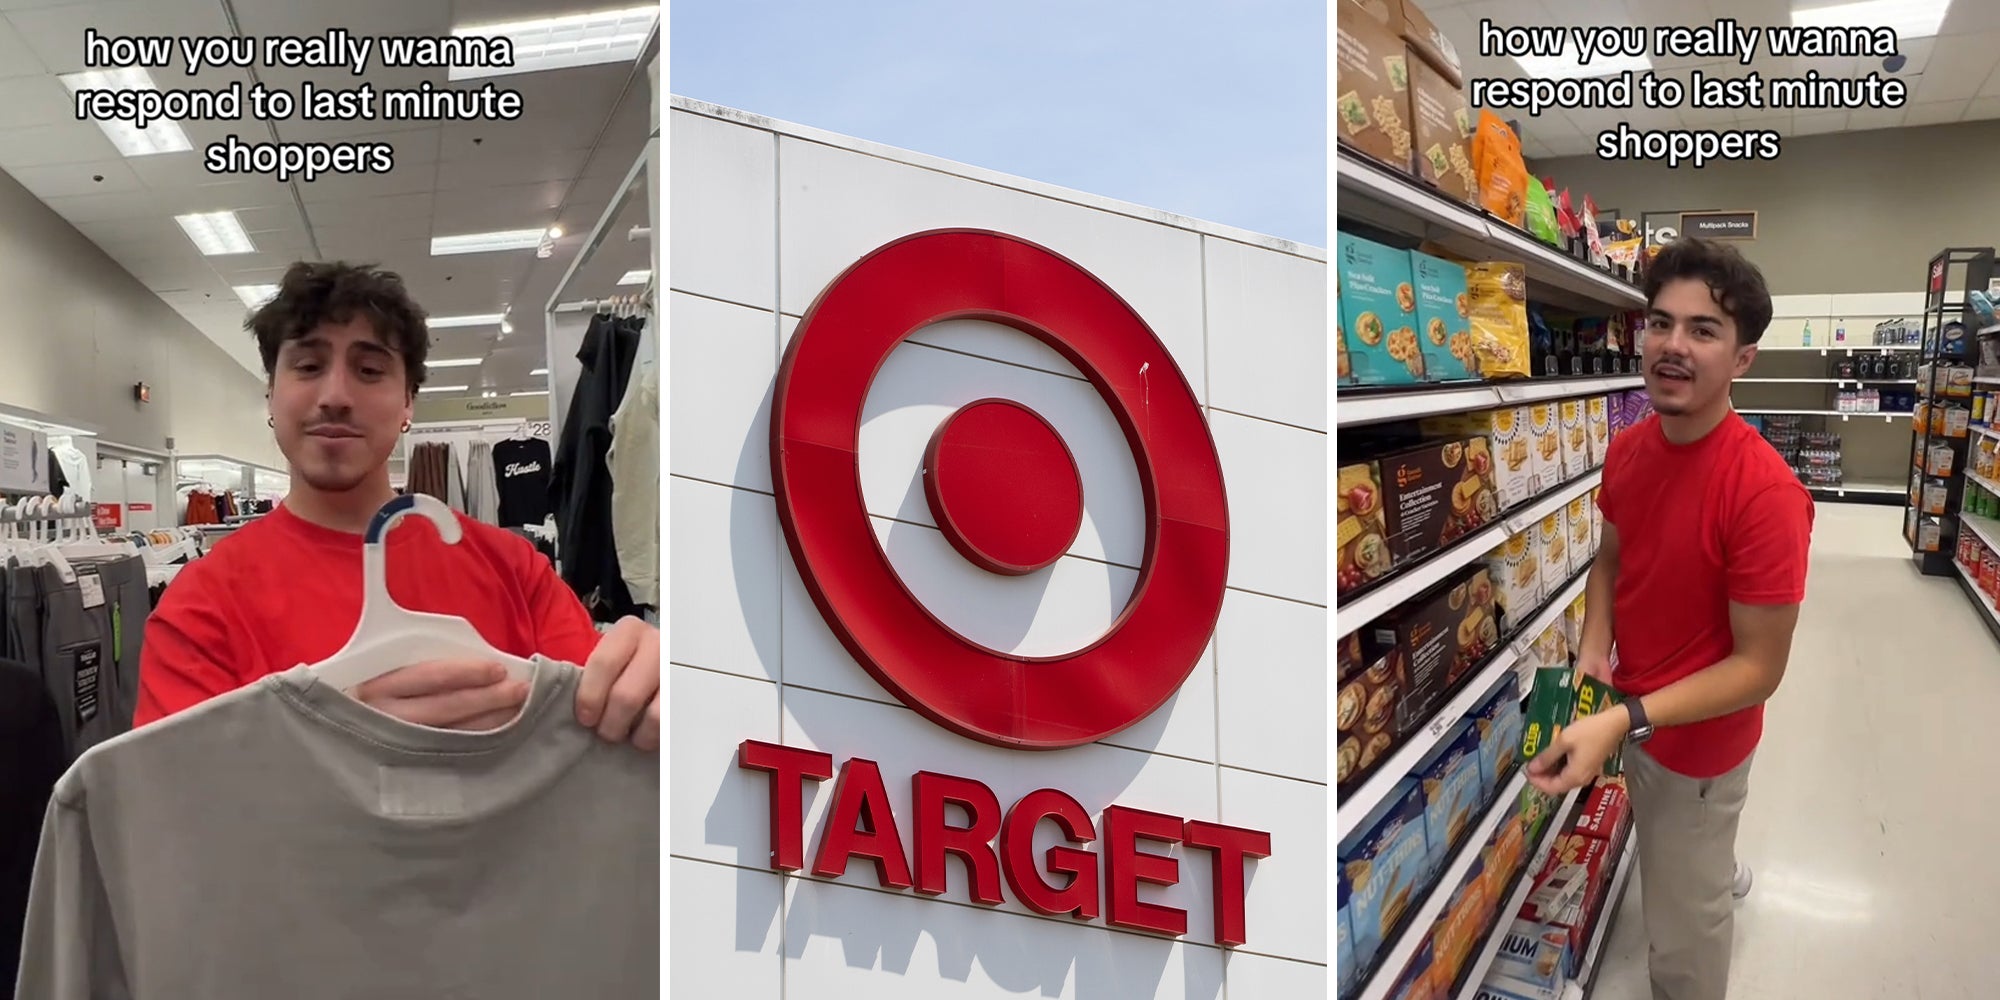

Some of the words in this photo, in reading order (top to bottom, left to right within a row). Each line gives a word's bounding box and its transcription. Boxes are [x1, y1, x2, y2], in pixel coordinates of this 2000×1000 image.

[1634, 220, 1678, 247] ts
[1699, 222, 1726, 231] Multipack
[1727, 221, 1749, 229] Snacks
[504, 461, 541, 478] Hustle
[1399, 482, 1443, 502] Entertainment
[1400, 494, 1432, 510] Collection
[1412, 626, 1449, 660] Entertainment
[1576, 684, 1594, 719] UB
[1523, 722, 1540, 756] CLUB
[1589, 788, 1613, 831] SALTINE
[738, 739, 1272, 946] TARGET
[1584, 837, 1597, 864] LTINE
[1356, 832, 1424, 918] NUT-THINS
[1500, 934, 1540, 958] IUM
